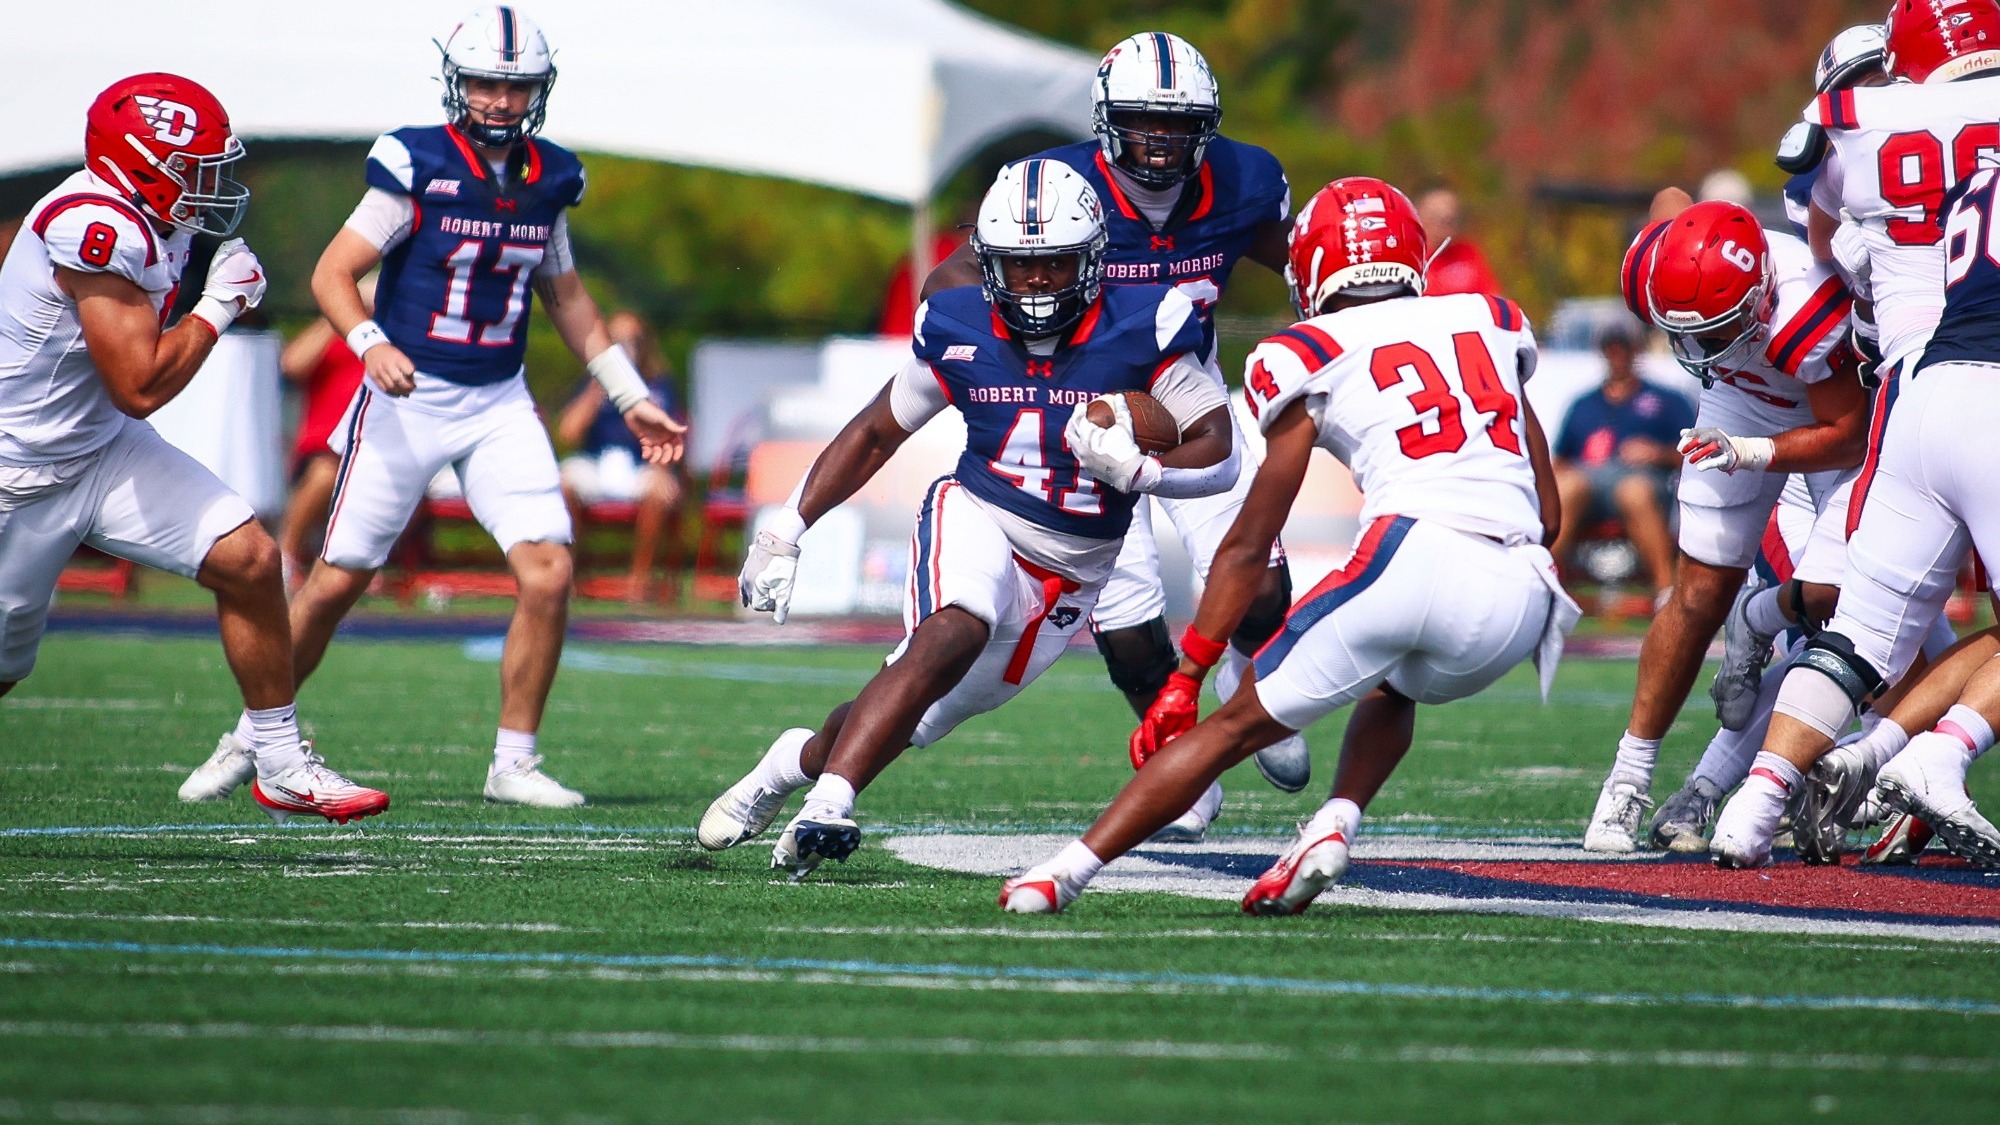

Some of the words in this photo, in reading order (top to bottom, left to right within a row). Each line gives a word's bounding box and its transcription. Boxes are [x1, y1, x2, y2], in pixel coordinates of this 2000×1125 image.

[441, 216, 502, 237] ROBERT
[79, 221, 118, 267] 8
[1721, 240, 1755, 272] 6
[1102, 263, 1160, 278] OBERT
[1169, 253, 1224, 276] MORRIS
[1354, 265, 1400, 279] schutt
[427, 240, 544, 346] 17
[969, 387, 1037, 402] ROBERT
[1370, 331, 1523, 460] 34
[987, 408, 1104, 517] 41
